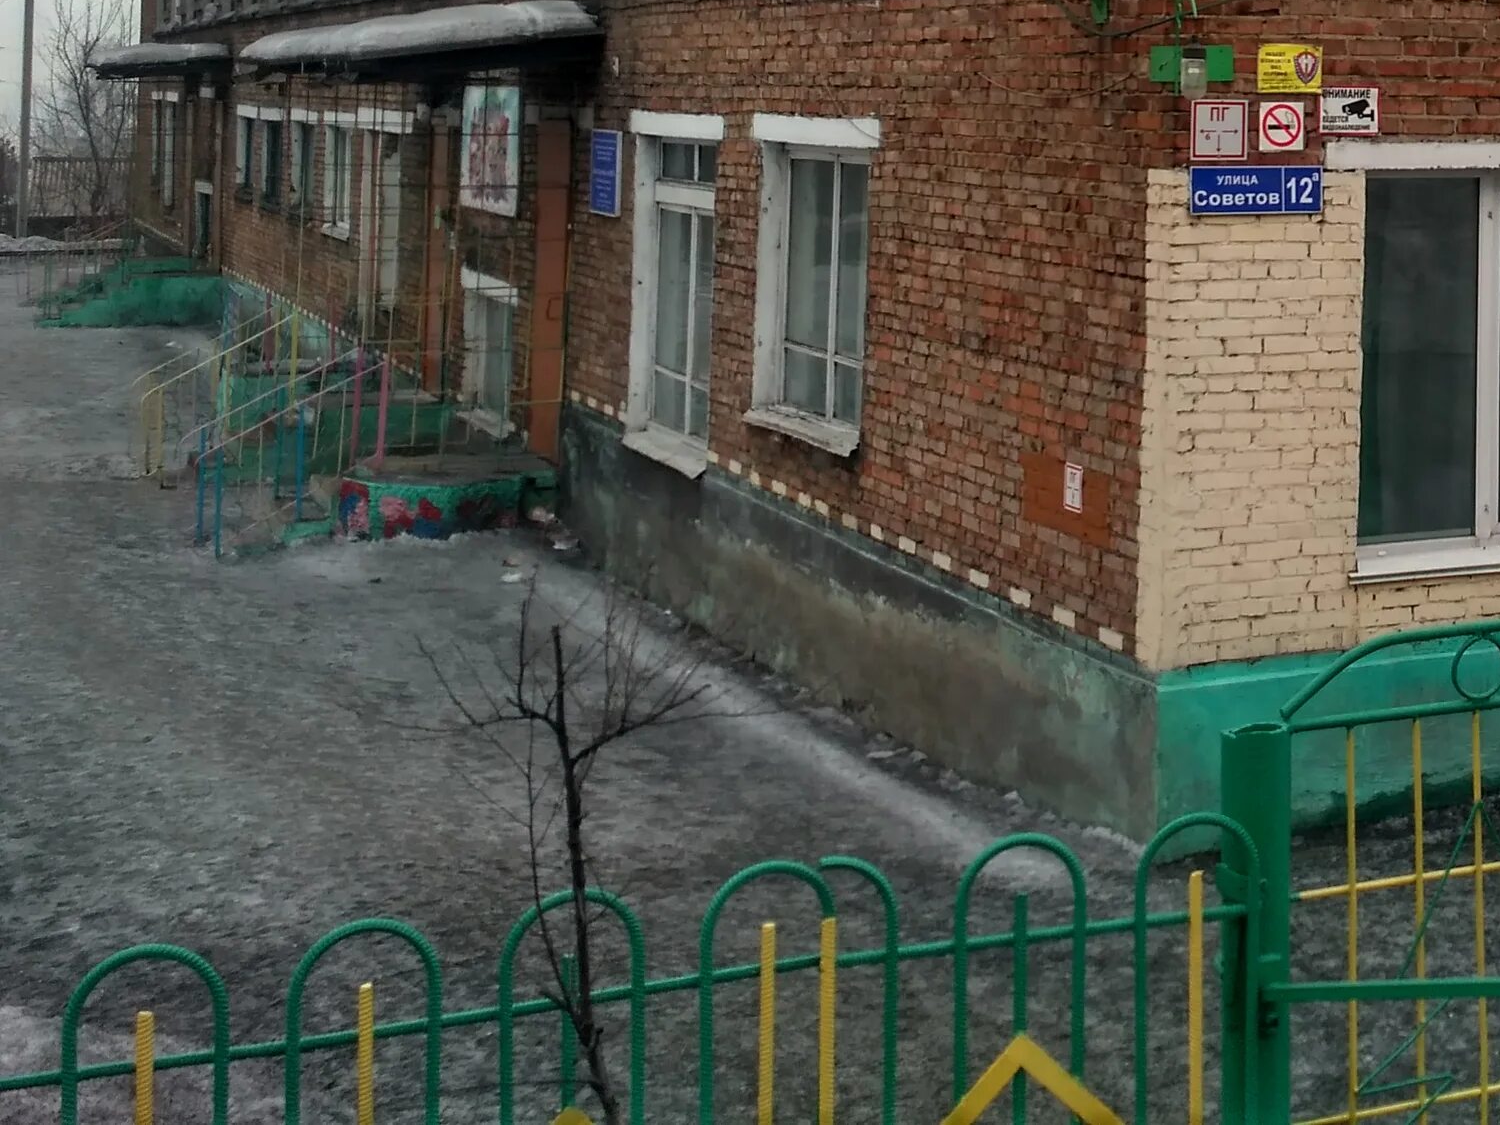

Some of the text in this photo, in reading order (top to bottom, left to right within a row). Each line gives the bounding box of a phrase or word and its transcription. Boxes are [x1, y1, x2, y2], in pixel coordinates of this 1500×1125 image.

[1210, 107, 1230, 121] ПГ
[1216, 175, 1259, 186] УЛИЦА
[1194, 190, 1280, 206] Советов
